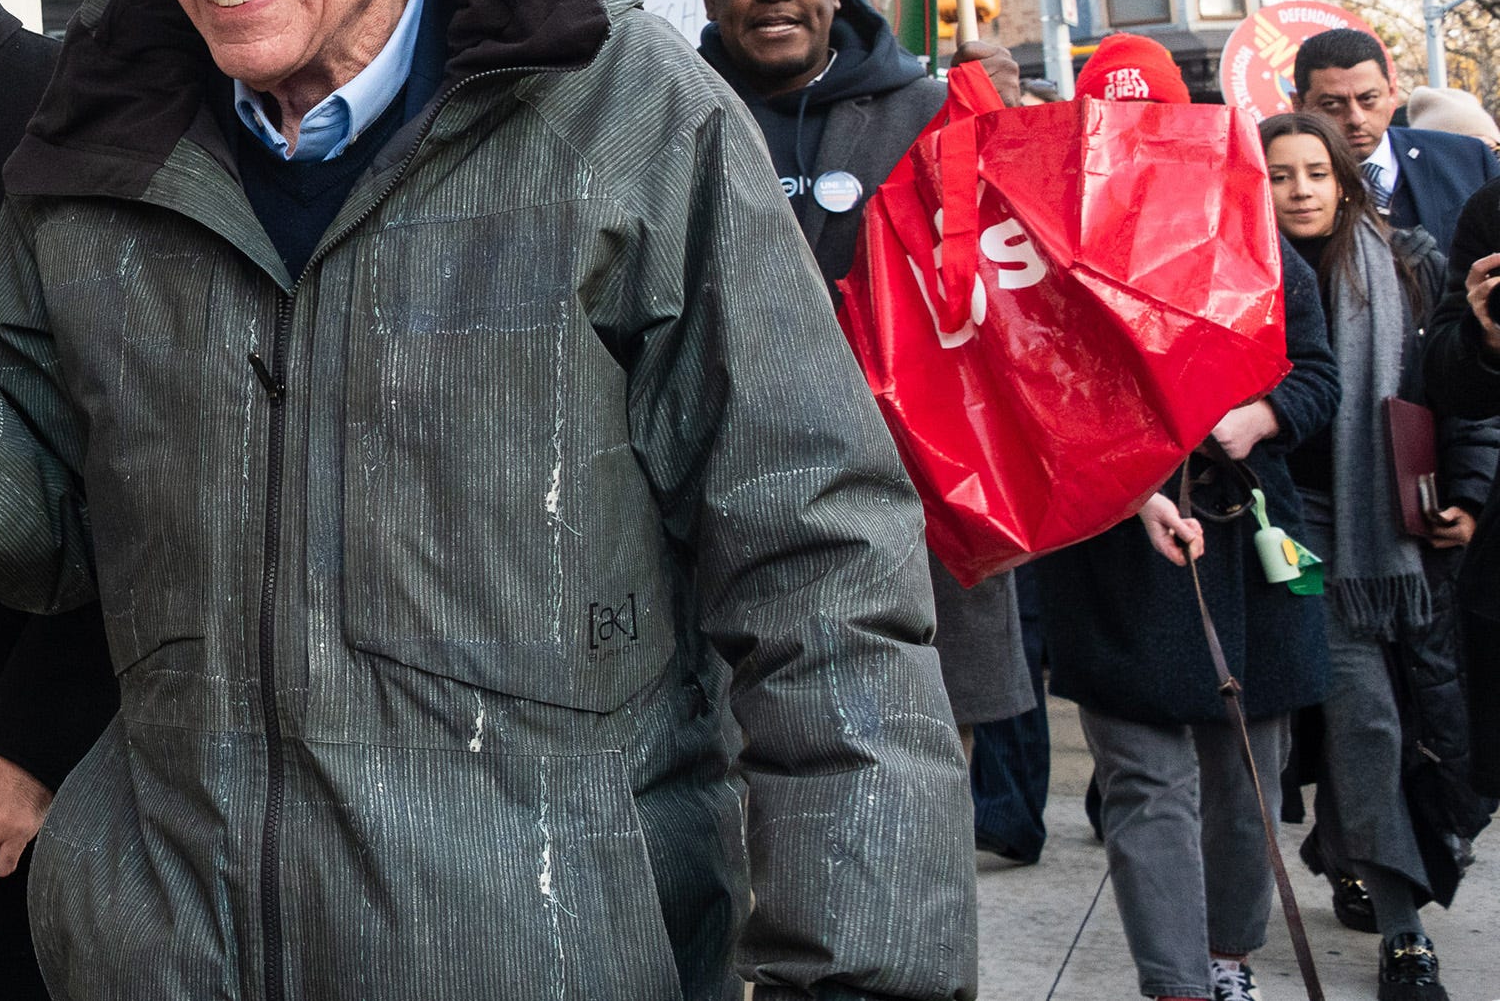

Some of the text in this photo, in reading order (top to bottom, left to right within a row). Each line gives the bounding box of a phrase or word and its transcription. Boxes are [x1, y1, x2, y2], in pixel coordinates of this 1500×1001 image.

[1277, 7, 1349, 30] DEFENDING
[1105, 68, 1141, 83] TAX
[1104, 79, 1150, 101] RICH
